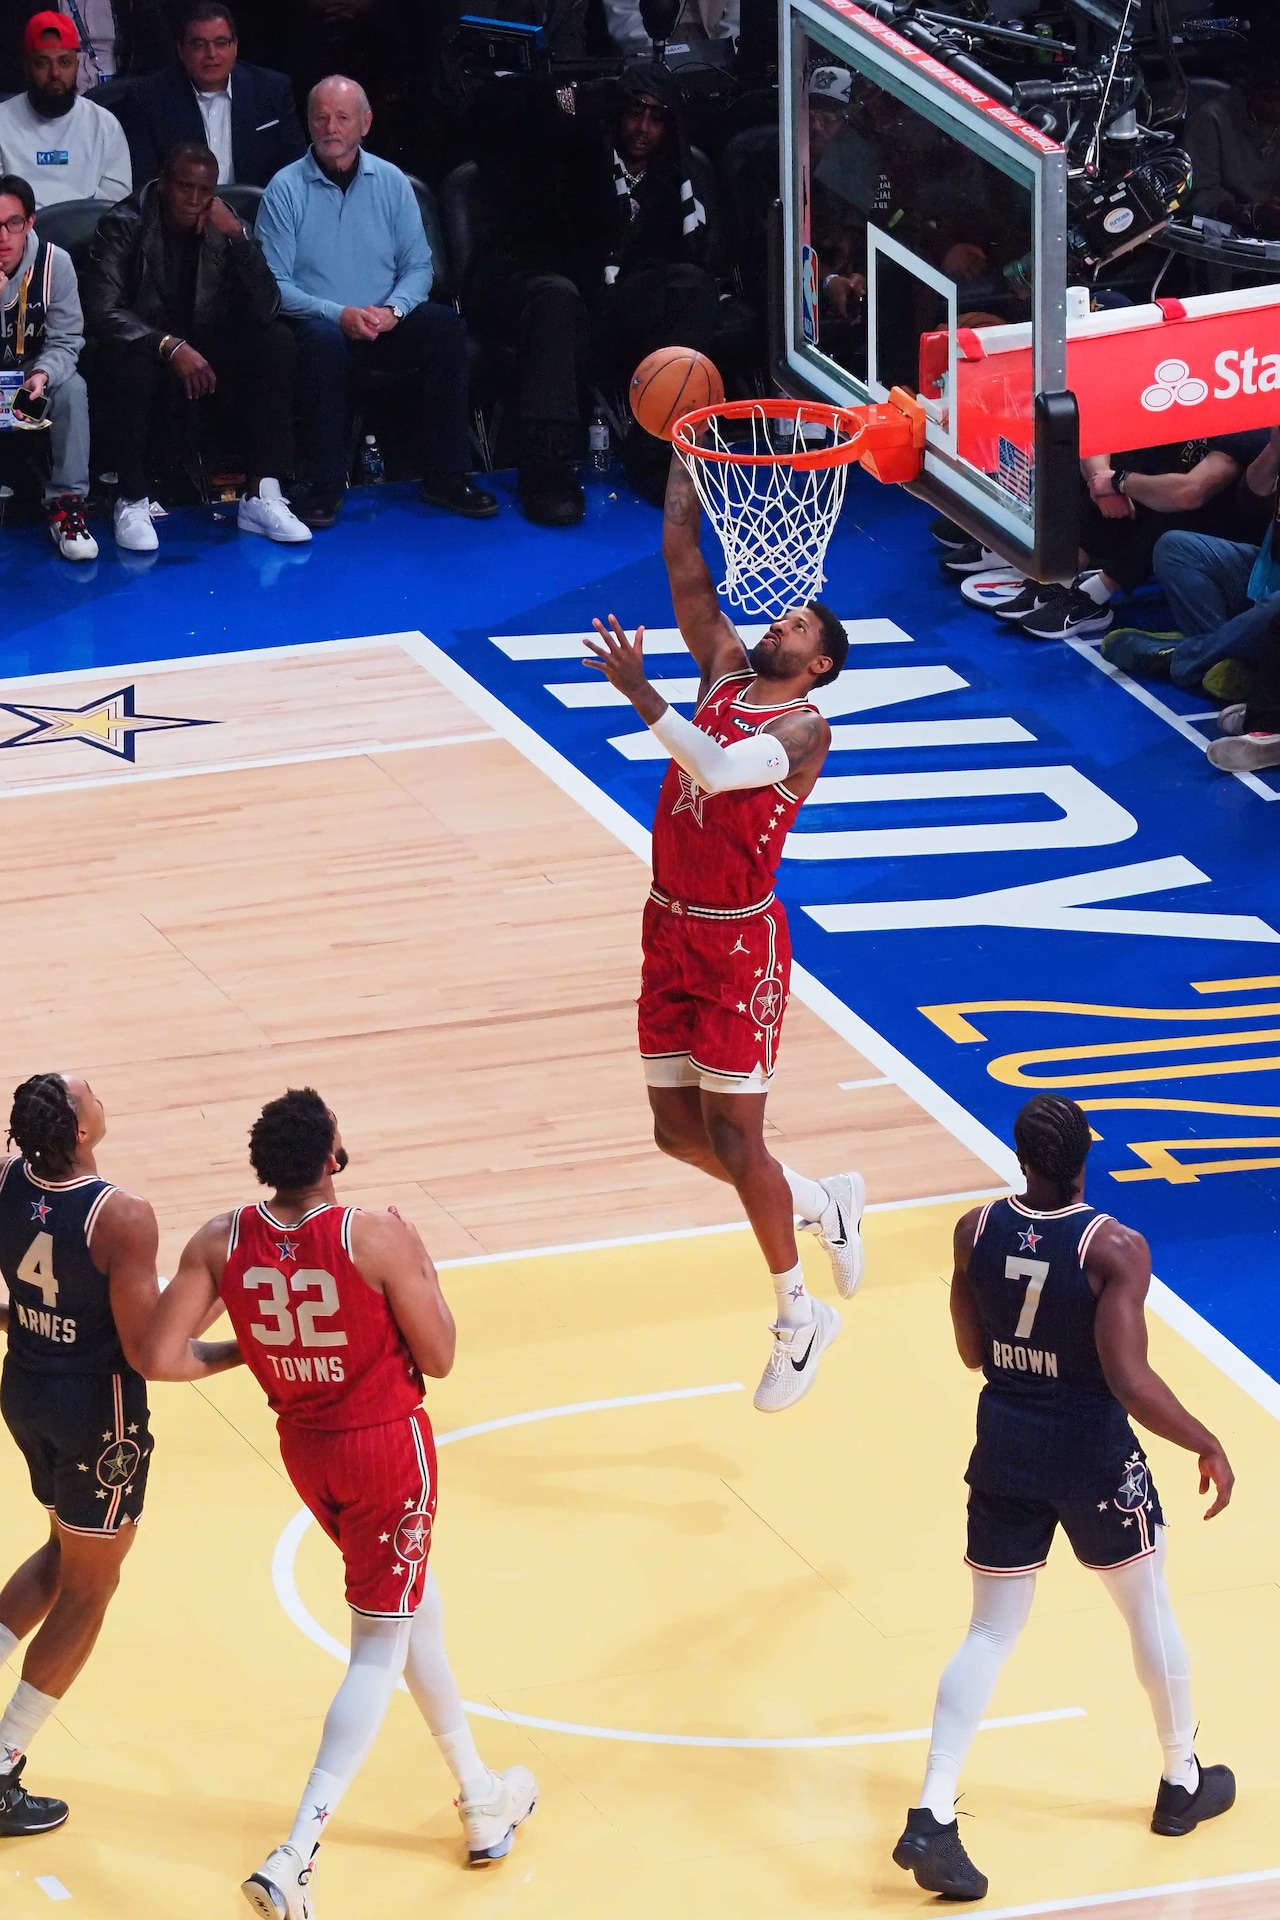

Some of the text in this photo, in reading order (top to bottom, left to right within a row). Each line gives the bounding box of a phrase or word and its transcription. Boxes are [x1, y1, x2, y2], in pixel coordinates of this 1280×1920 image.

[1213, 346, 1280, 400] Sta
[16, 1230, 60, 1308] 4
[14, 1299, 77, 1344] ARNES
[242, 1266, 349, 1347] 32
[1004, 1255, 1050, 1339] 7
[266, 1354, 345, 1383] TOWNS
[992, 1339, 1059, 1379] BROWN
